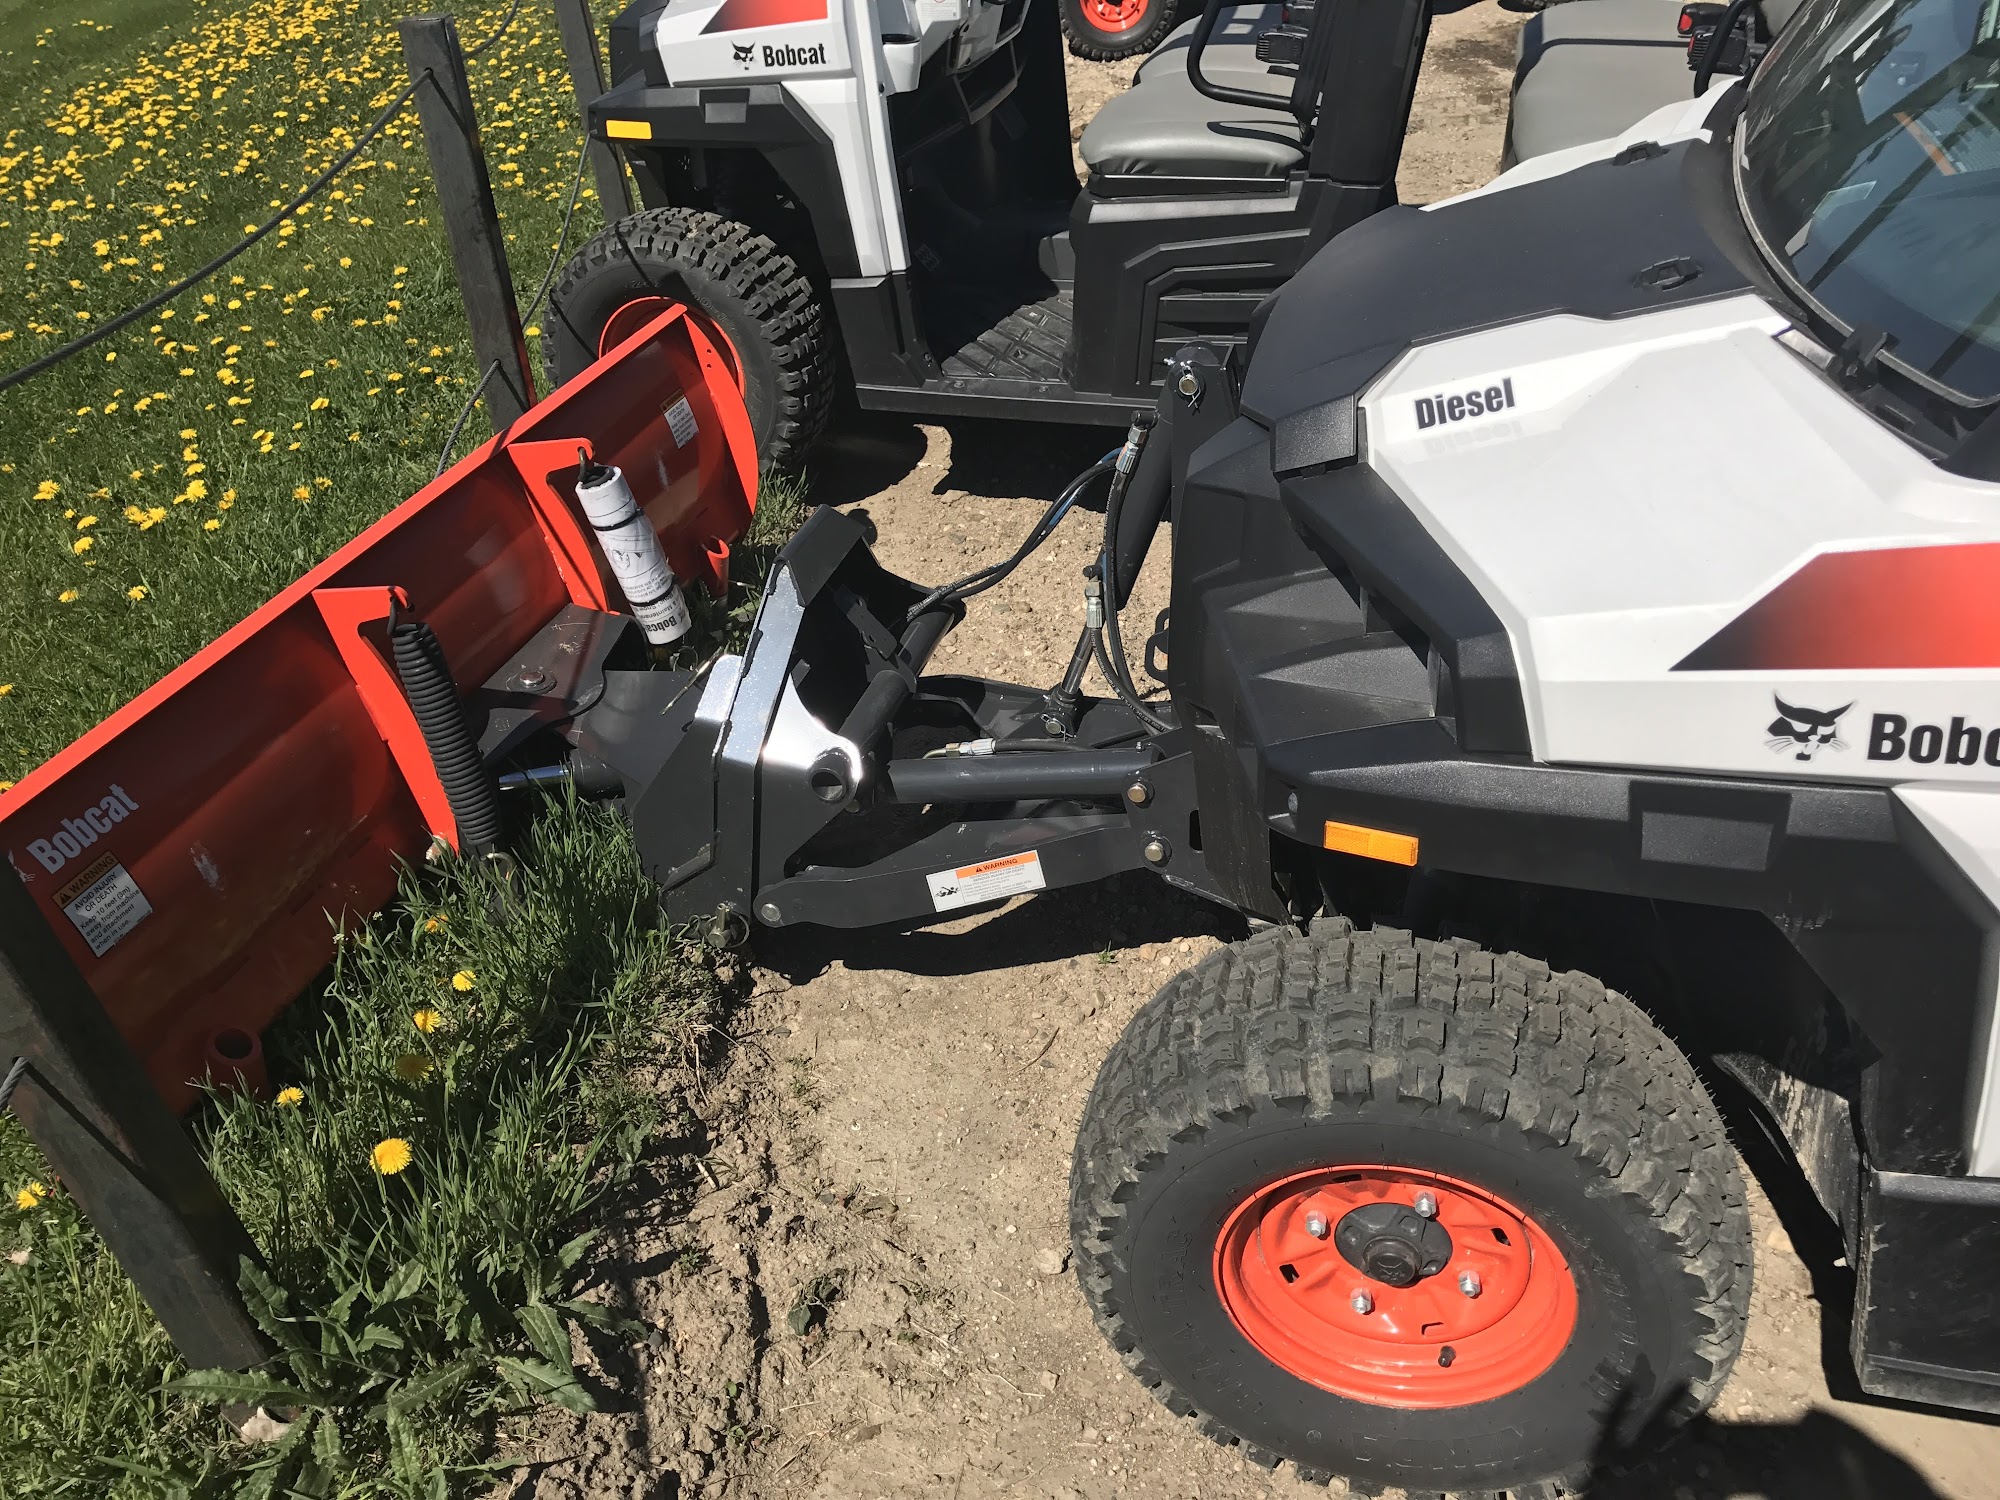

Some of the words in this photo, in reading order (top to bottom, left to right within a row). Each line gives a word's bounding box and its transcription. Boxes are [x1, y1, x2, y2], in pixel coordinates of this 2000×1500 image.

[762, 43, 827, 67] Bobcat
[1414, 377, 1515, 430] Diesel
[645, 615, 678, 632] Bobca
[26, 783, 139, 874] Bobcat
[69, 856, 114, 894] WARNING
[983, 858, 1018, 871] WARNING
[74, 891, 95, 910] AVOID
[93, 872, 117, 895] INJURY
[80, 914, 97, 930] Keep
[96, 907, 105, 916] 10
[105, 897, 118, 910] feet
[116, 886, 131, 900] (3m)
[85, 902, 97, 912] OR
[96, 884, 118, 903] DEATH
[85, 922, 102, 937] away
[101, 910, 116, 923] from
[115, 889, 140, 912] machine
[91, 931, 103, 944] and
[103, 903, 135, 934] attachment
[95, 935, 112, 950] when
[111, 928, 118, 936] in
